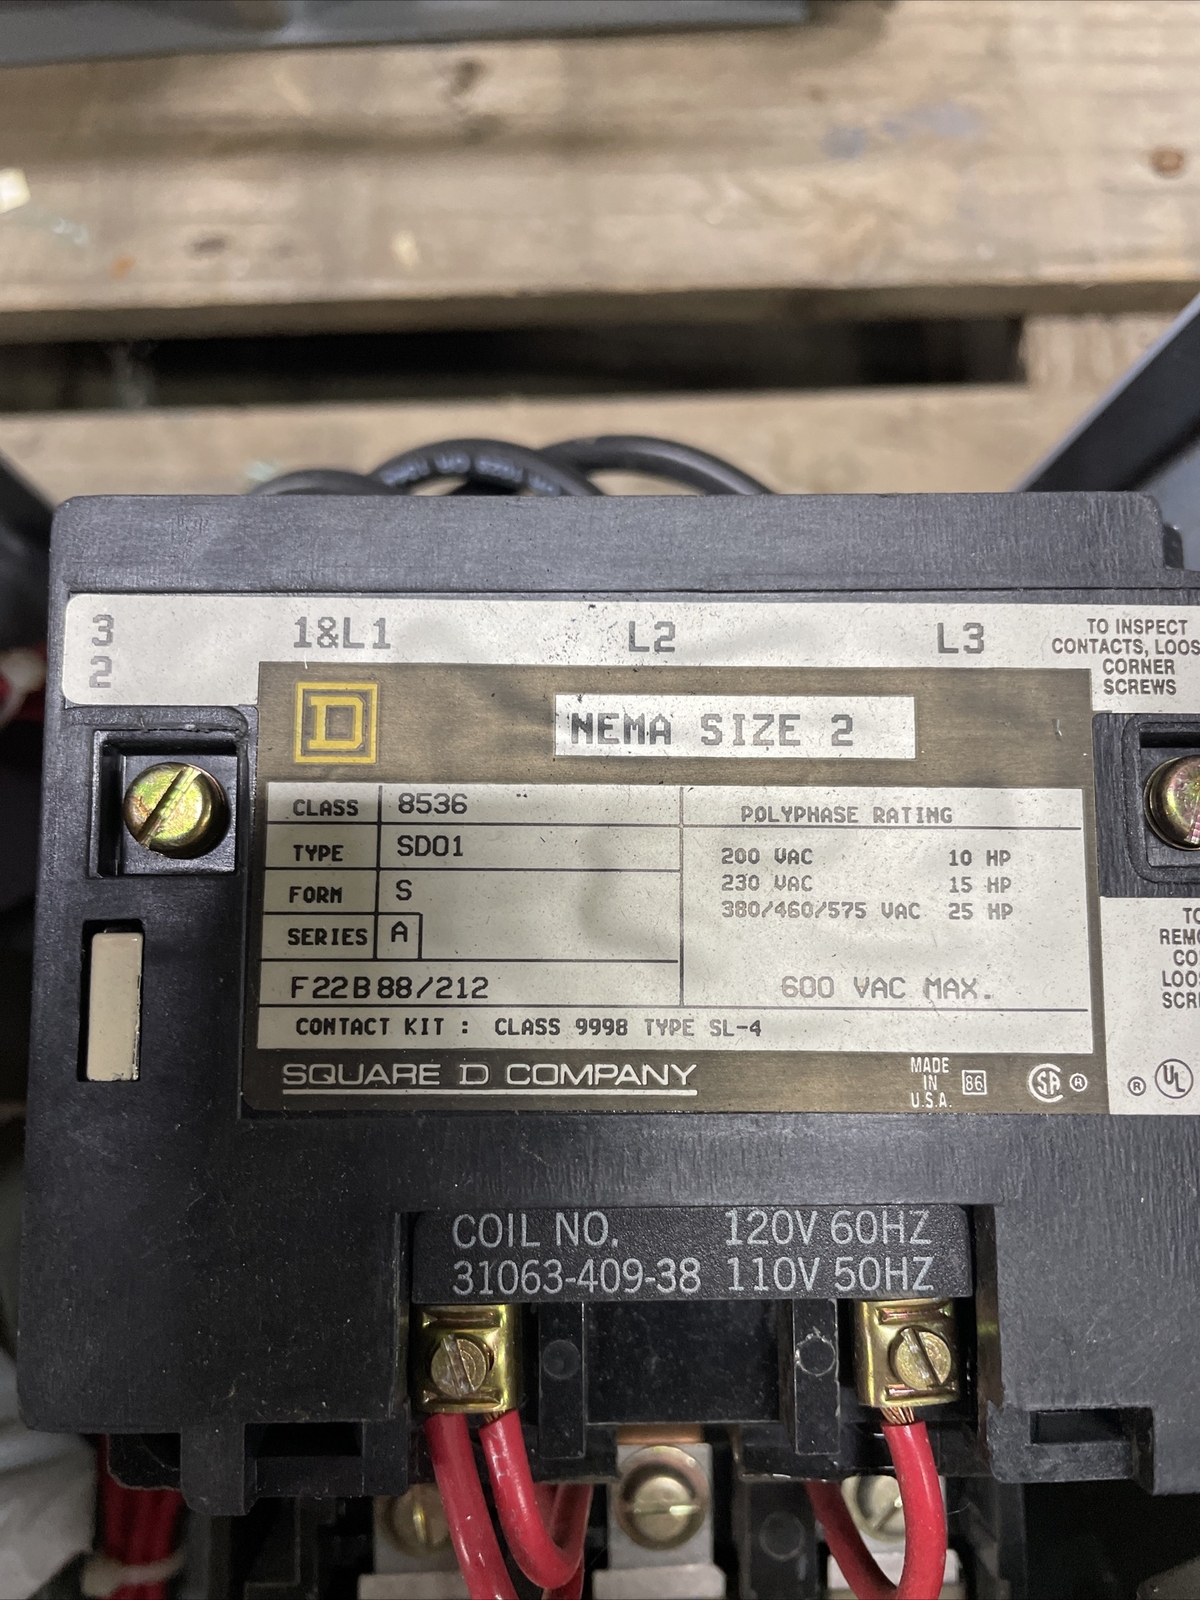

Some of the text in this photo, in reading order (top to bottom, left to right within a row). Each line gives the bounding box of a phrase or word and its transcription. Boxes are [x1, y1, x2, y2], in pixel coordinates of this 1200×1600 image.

[92, 614, 114, 647] 3
[293, 616, 391, 649] 1&L1
[628, 621, 676, 653] L2
[1087, 618, 1188, 636] TO INSPECT
[937, 622, 985, 654] L3
[1051, 637, 1149, 658] CONTACTS,
[89, 655, 113, 688] 2
[1102, 658, 1175, 675] CORNER
[1103, 678, 1177, 695] SCREWS
[571, 712, 854, 747] NEMA SIZE 2
[293, 793, 468, 817] CLASS 8536
[740, 805, 953, 824] POLYPHASE RATING
[293, 844, 344, 862] TYPE
[721, 847, 1011, 867] 200 VAC 10 HP
[289, 879, 412, 903] FORM S
[721, 874, 1012, 894] 230 VAC 15 HP
[721, 900, 1014, 920] 380/460/575 VAC 25 HP
[287, 921, 409, 946] SERIES A
[1173, 949, 1200, 966] CO
[781, 976, 994, 999] 600 VAC MAX.
[1161, 970, 1200, 987] LOO
[1162, 992, 1200, 1009] SCR
[295, 1018, 390, 1036] CONTACT
[404, 1018, 444, 1036] KIT
[494, 1018, 561, 1036] CLASS
[575, 1018, 628, 1036] 9998
[644, 1018, 695, 1036] TYPE
[709, 1019, 761, 1037] SL-4
[282, 1063, 697, 1086] SQUARE D COMPANY
[910, 1057, 950, 1074] MADE
[923, 1074, 938, 1091] IN
[965, 1075, 983, 1091] 86
[910, 1091, 952, 1109] U.S.A.
[452, 1211, 620, 1249] COIL NO.
[725, 1210, 933, 1247] 120V 60HZ
[452, 1258, 701, 1295] 31063-409-38
[727, 1256, 935, 1292] 110V 50HZ
